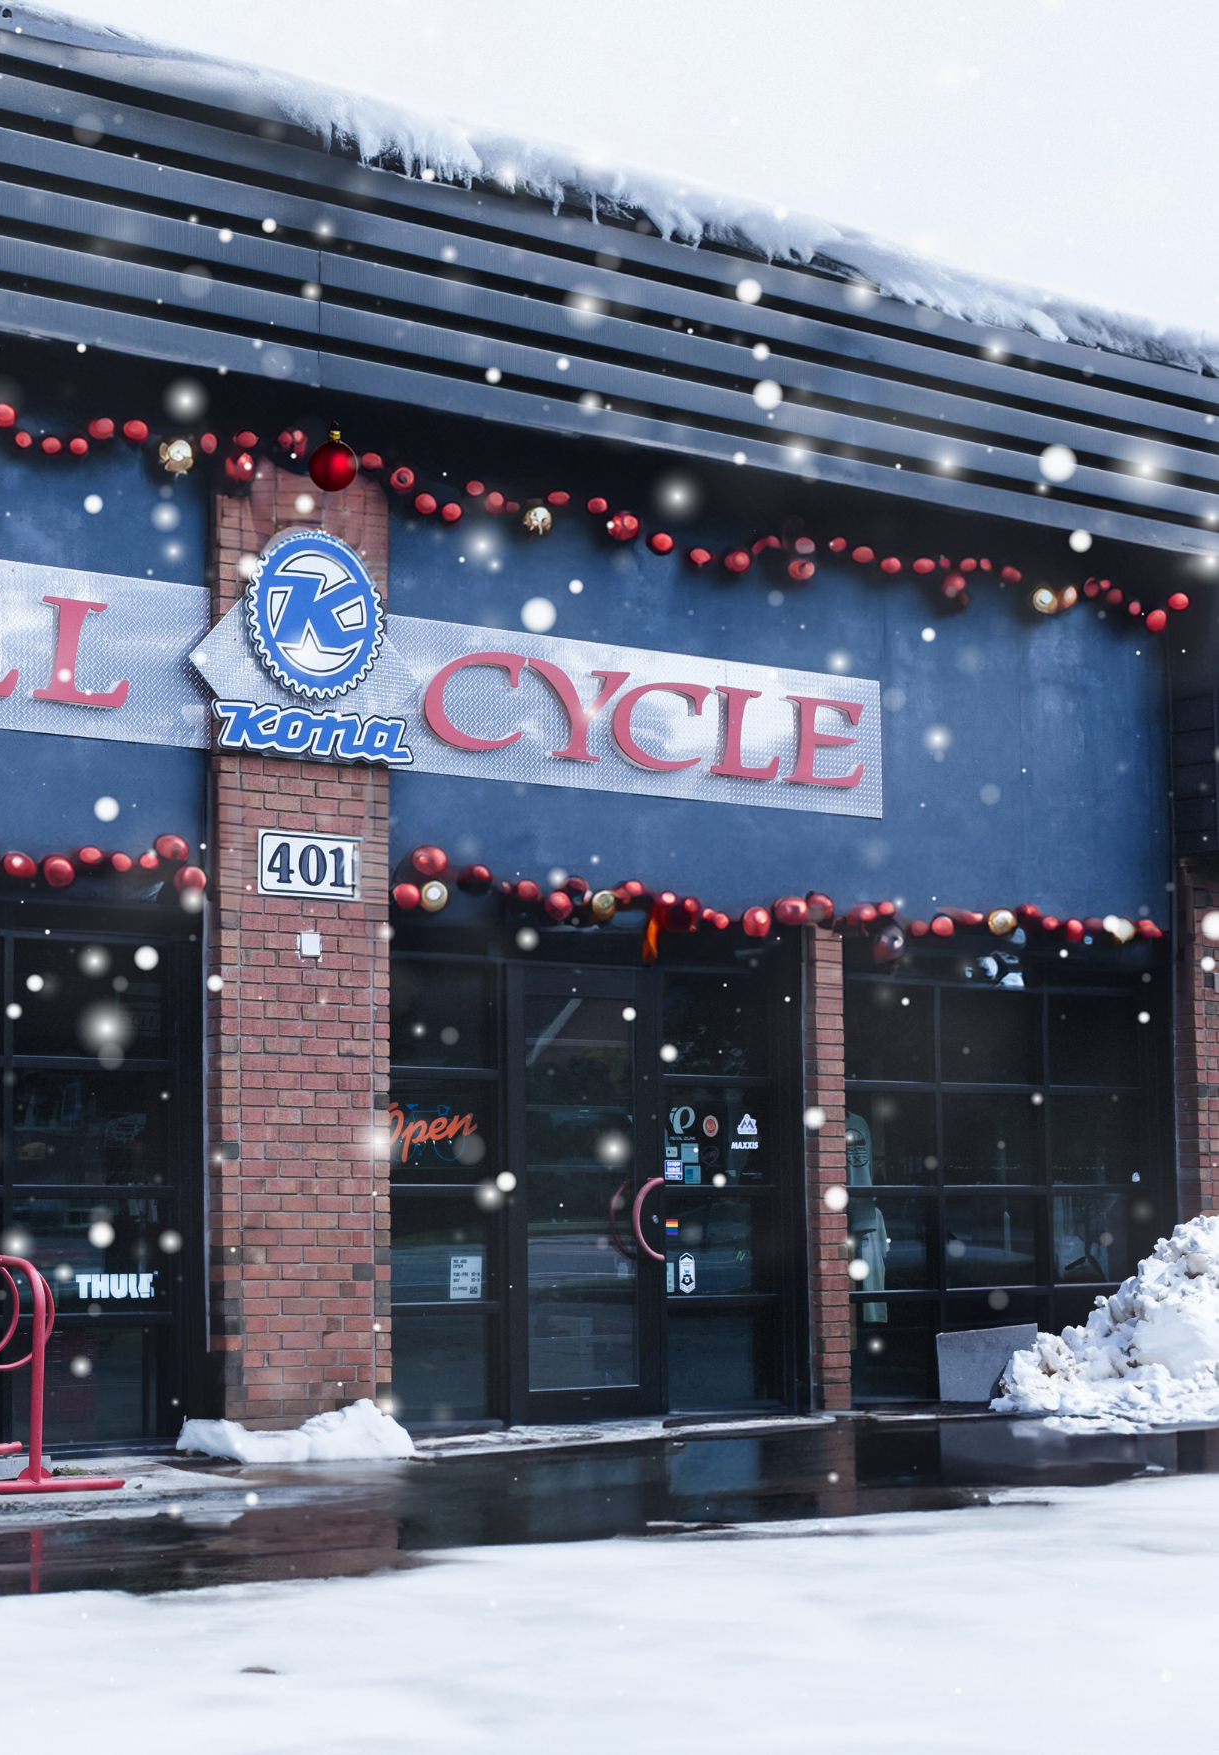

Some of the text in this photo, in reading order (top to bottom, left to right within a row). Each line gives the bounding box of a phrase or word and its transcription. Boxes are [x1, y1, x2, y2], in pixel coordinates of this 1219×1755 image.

[422, 650, 865, 789] CYCLE
[267, 841, 350, 888] 401
[731, 1141, 758, 1149] MAXXIS
